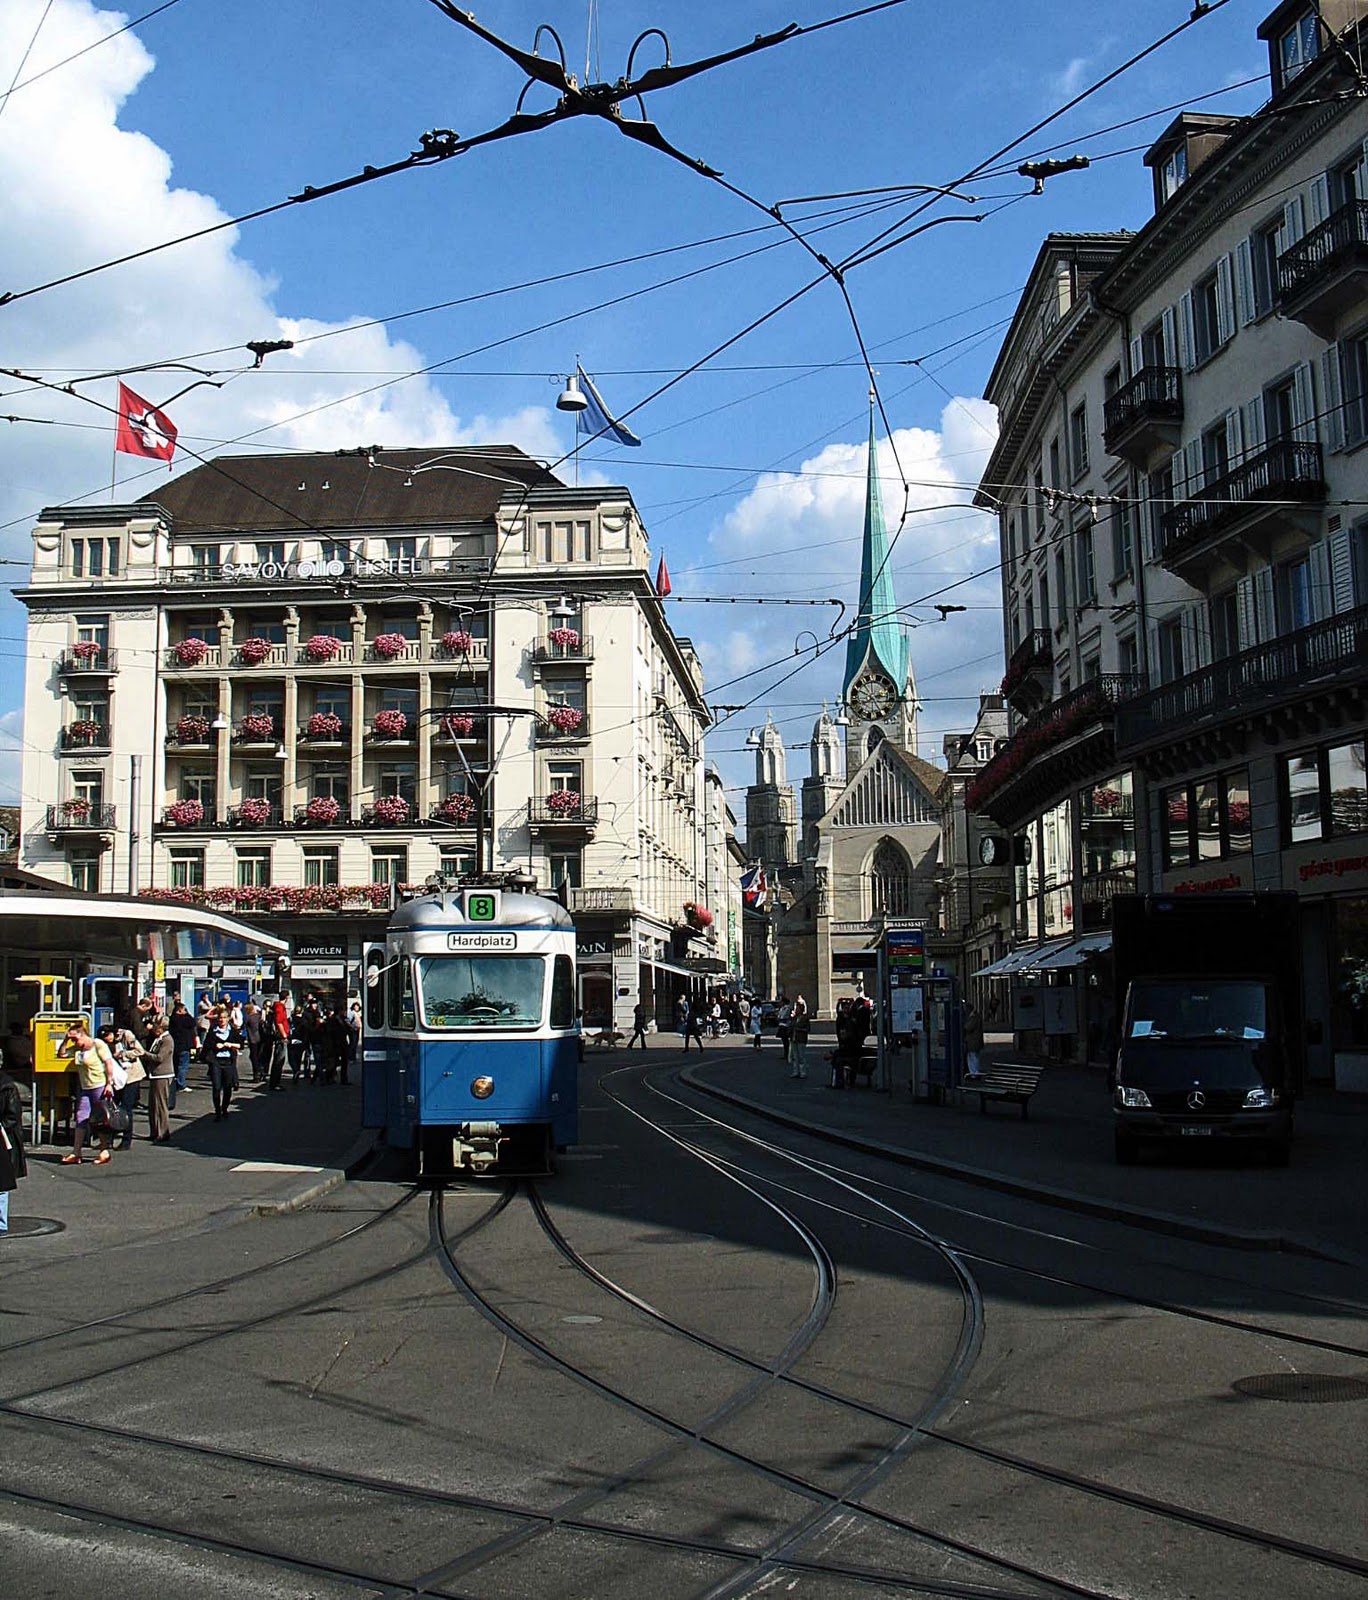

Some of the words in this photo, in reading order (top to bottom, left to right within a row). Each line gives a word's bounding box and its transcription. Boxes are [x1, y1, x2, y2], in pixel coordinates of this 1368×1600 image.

[222, 561, 290, 578] SAVOY
[356, 557, 423, 575] HOTEL
[475, 899, 489, 916] 8
[452, 935, 512, 948] Hardplatz
[297, 946, 342, 955] JUWELEN
